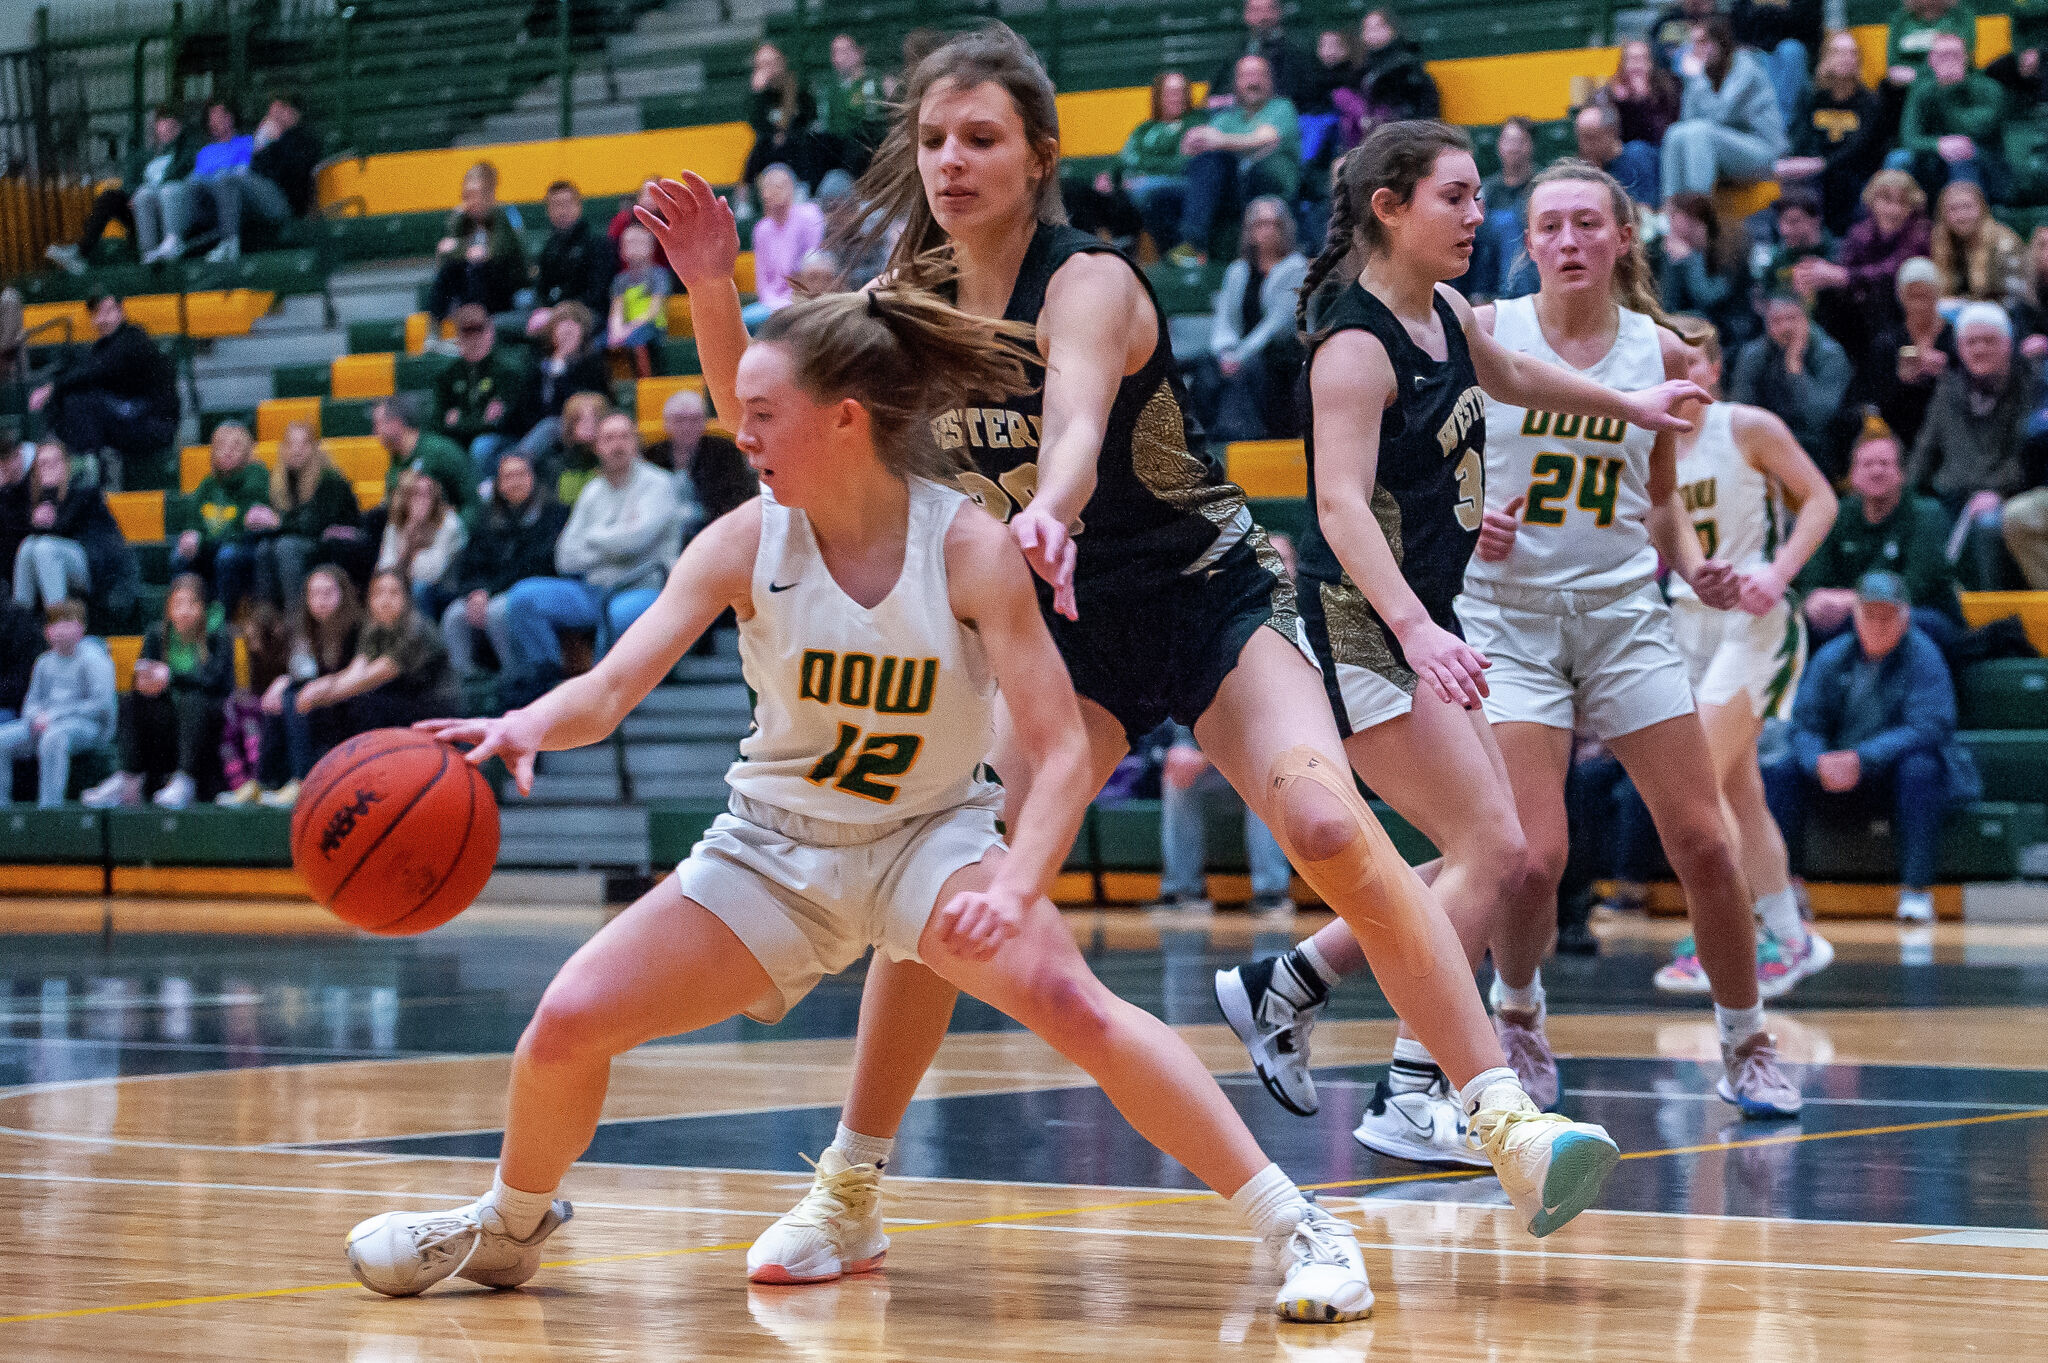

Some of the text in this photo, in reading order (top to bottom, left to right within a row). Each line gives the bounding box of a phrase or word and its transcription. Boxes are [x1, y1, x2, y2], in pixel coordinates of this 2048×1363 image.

[1522, 451, 1626, 529] 24
[799, 648, 939, 716] DOW
[803, 721, 924, 805] 12
